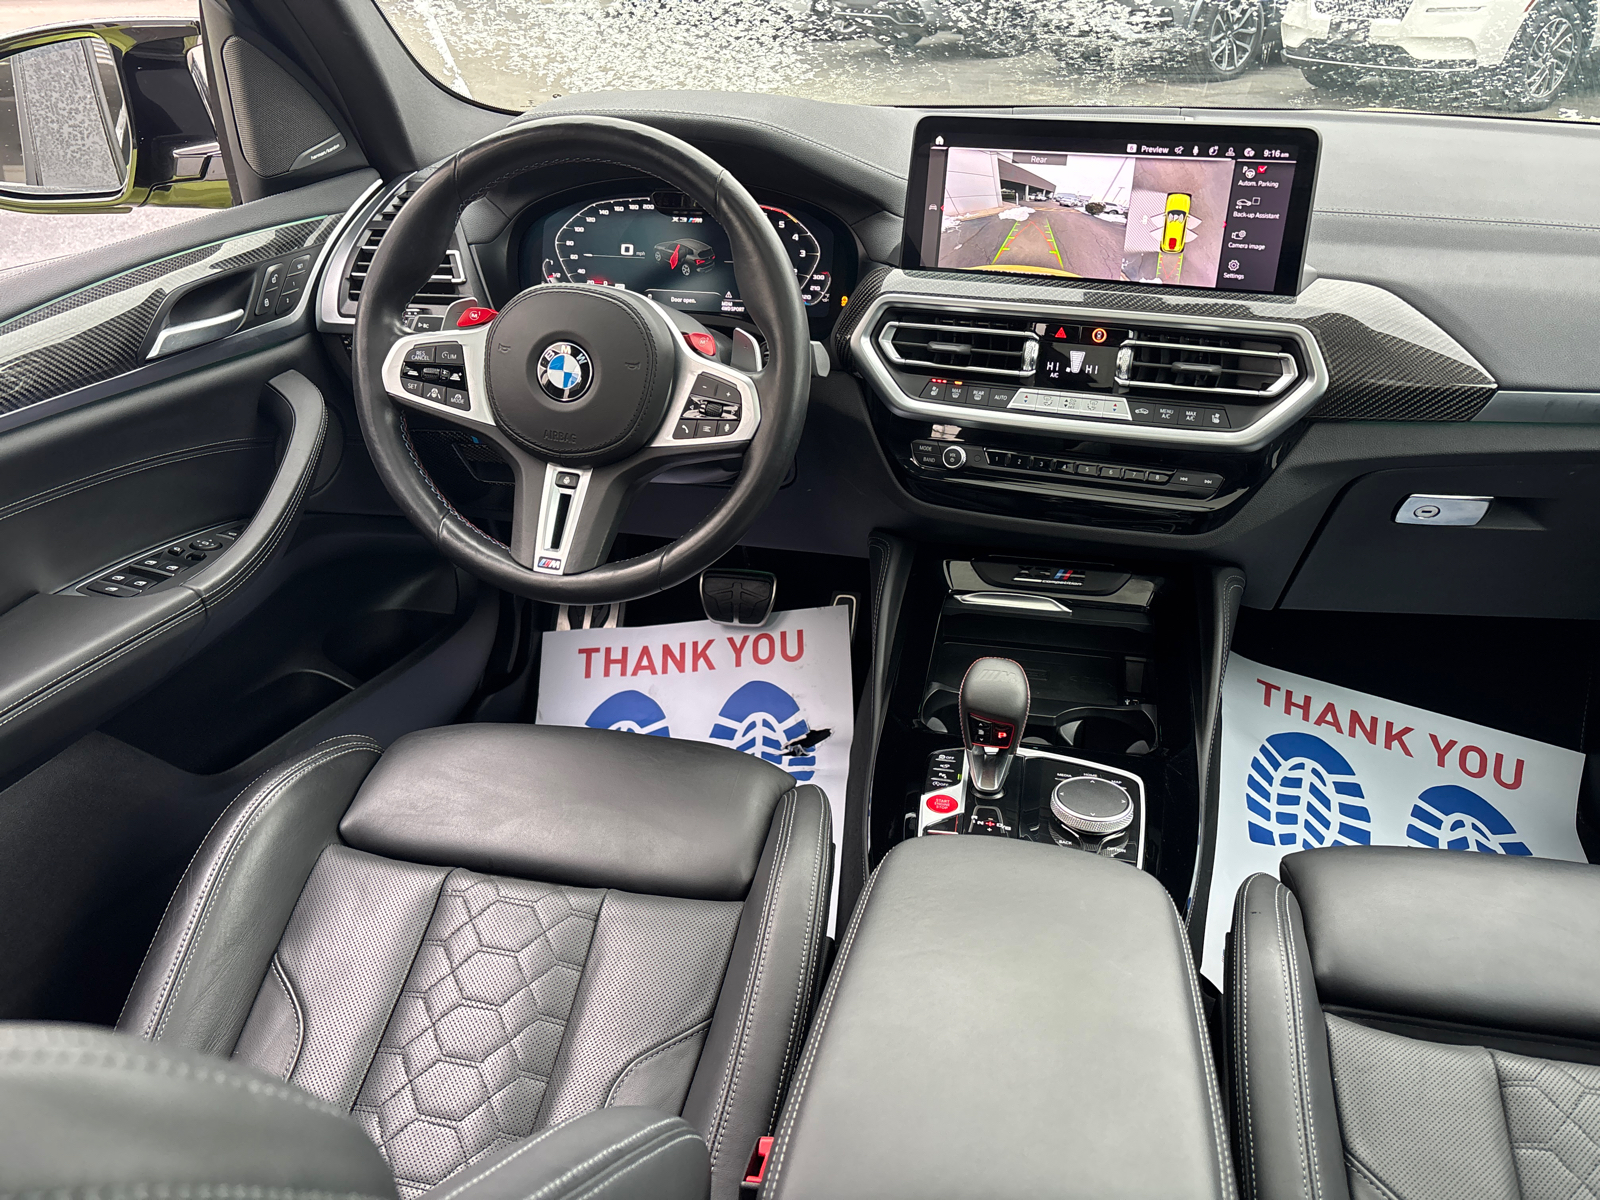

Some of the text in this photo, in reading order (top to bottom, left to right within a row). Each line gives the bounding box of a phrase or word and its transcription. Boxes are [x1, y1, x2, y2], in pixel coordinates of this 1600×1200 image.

[1141, 146, 1169, 154] Preview
[1263, 150, 1280, 158] 9:16
[778, 220, 786, 228] 5
[620, 243, 634, 256] 0
[799, 250, 806, 258] 3
[544, 344, 588, 364] BMW
[1046, 362, 1060, 371] HI
[1086, 365, 1099, 374] HI
[543, 430, 577, 444] AIRBAG
[578, 629, 804, 679] THANK YOU
[1256, 678, 1525, 790] THANK YOU
